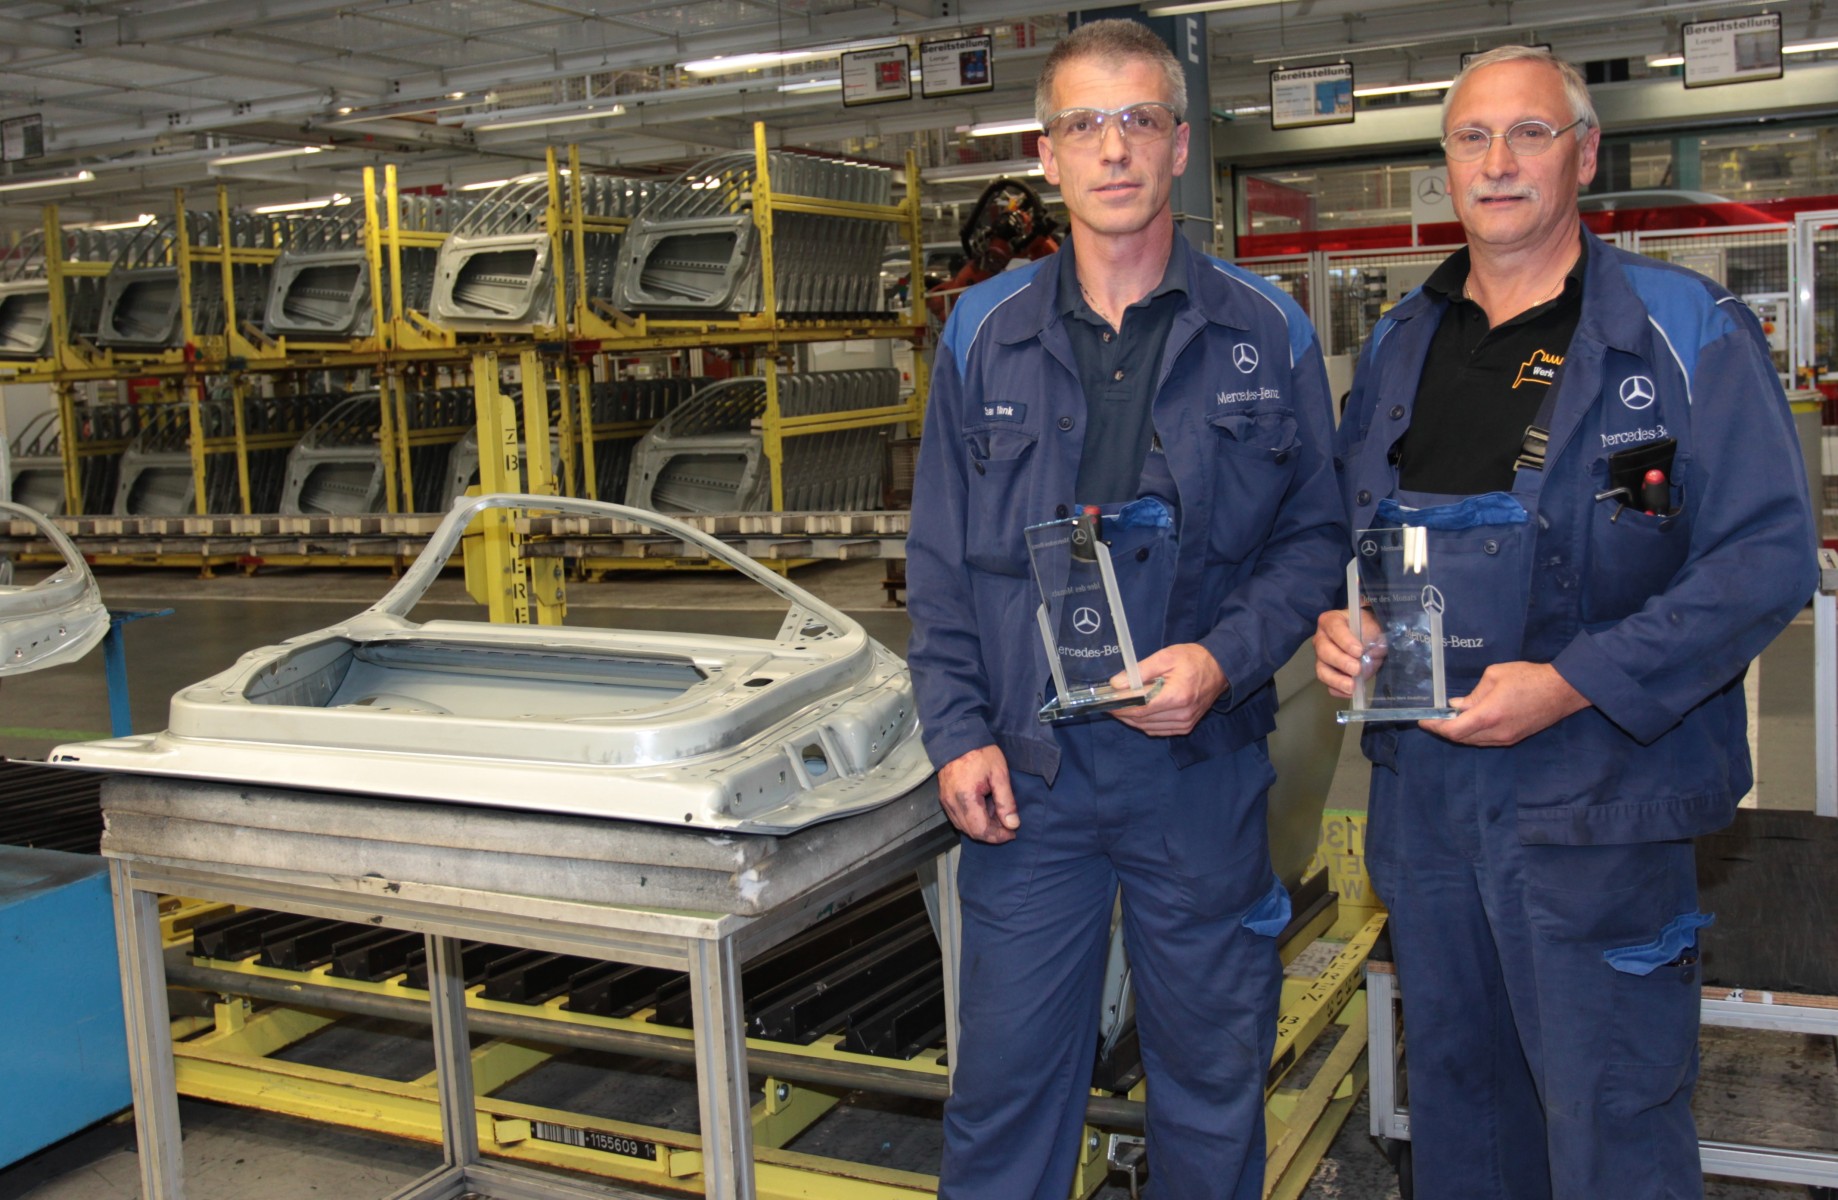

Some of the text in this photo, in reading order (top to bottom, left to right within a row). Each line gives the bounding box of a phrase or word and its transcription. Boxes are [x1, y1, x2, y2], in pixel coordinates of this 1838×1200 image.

[1685, 17, 1780, 36] Bereitstellung
[922, 39, 990, 54] Bereitstellung
[1186, 17, 1200, 64] E
[1273, 67, 1352, 82] Bereitstellung
[590, 1133, 638, 1155] 1155609
